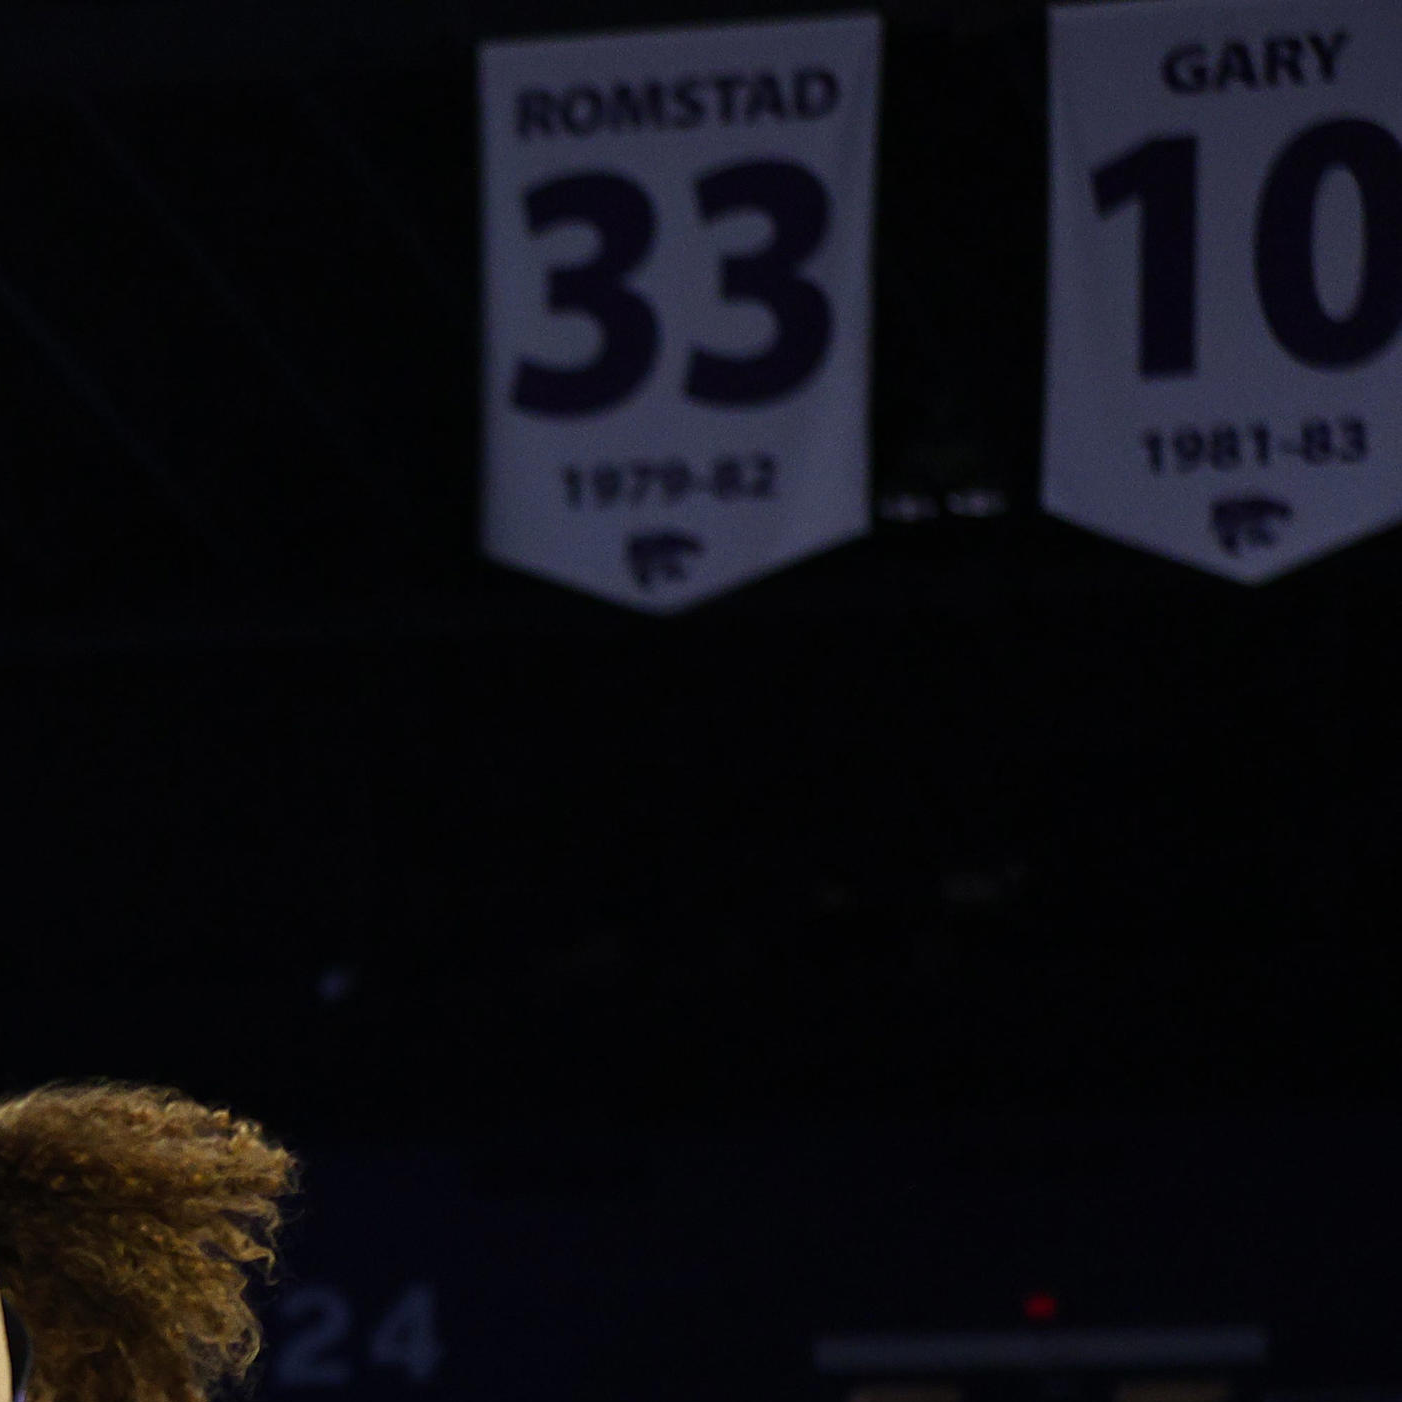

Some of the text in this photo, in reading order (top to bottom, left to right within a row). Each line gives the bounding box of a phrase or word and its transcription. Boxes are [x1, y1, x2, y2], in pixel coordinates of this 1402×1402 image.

[1161, 30, 1348, 94] GARY
[513, 66, 840, 138] ROMSTAD
[1092, 118, 1402, 378] 10
[513, 158, 833, 420] 33
[1142, 416, 1368, 472] 1981-83
[561, 454, 777, 509] 1979-82
[277, 1280, 448, 1390] 24
